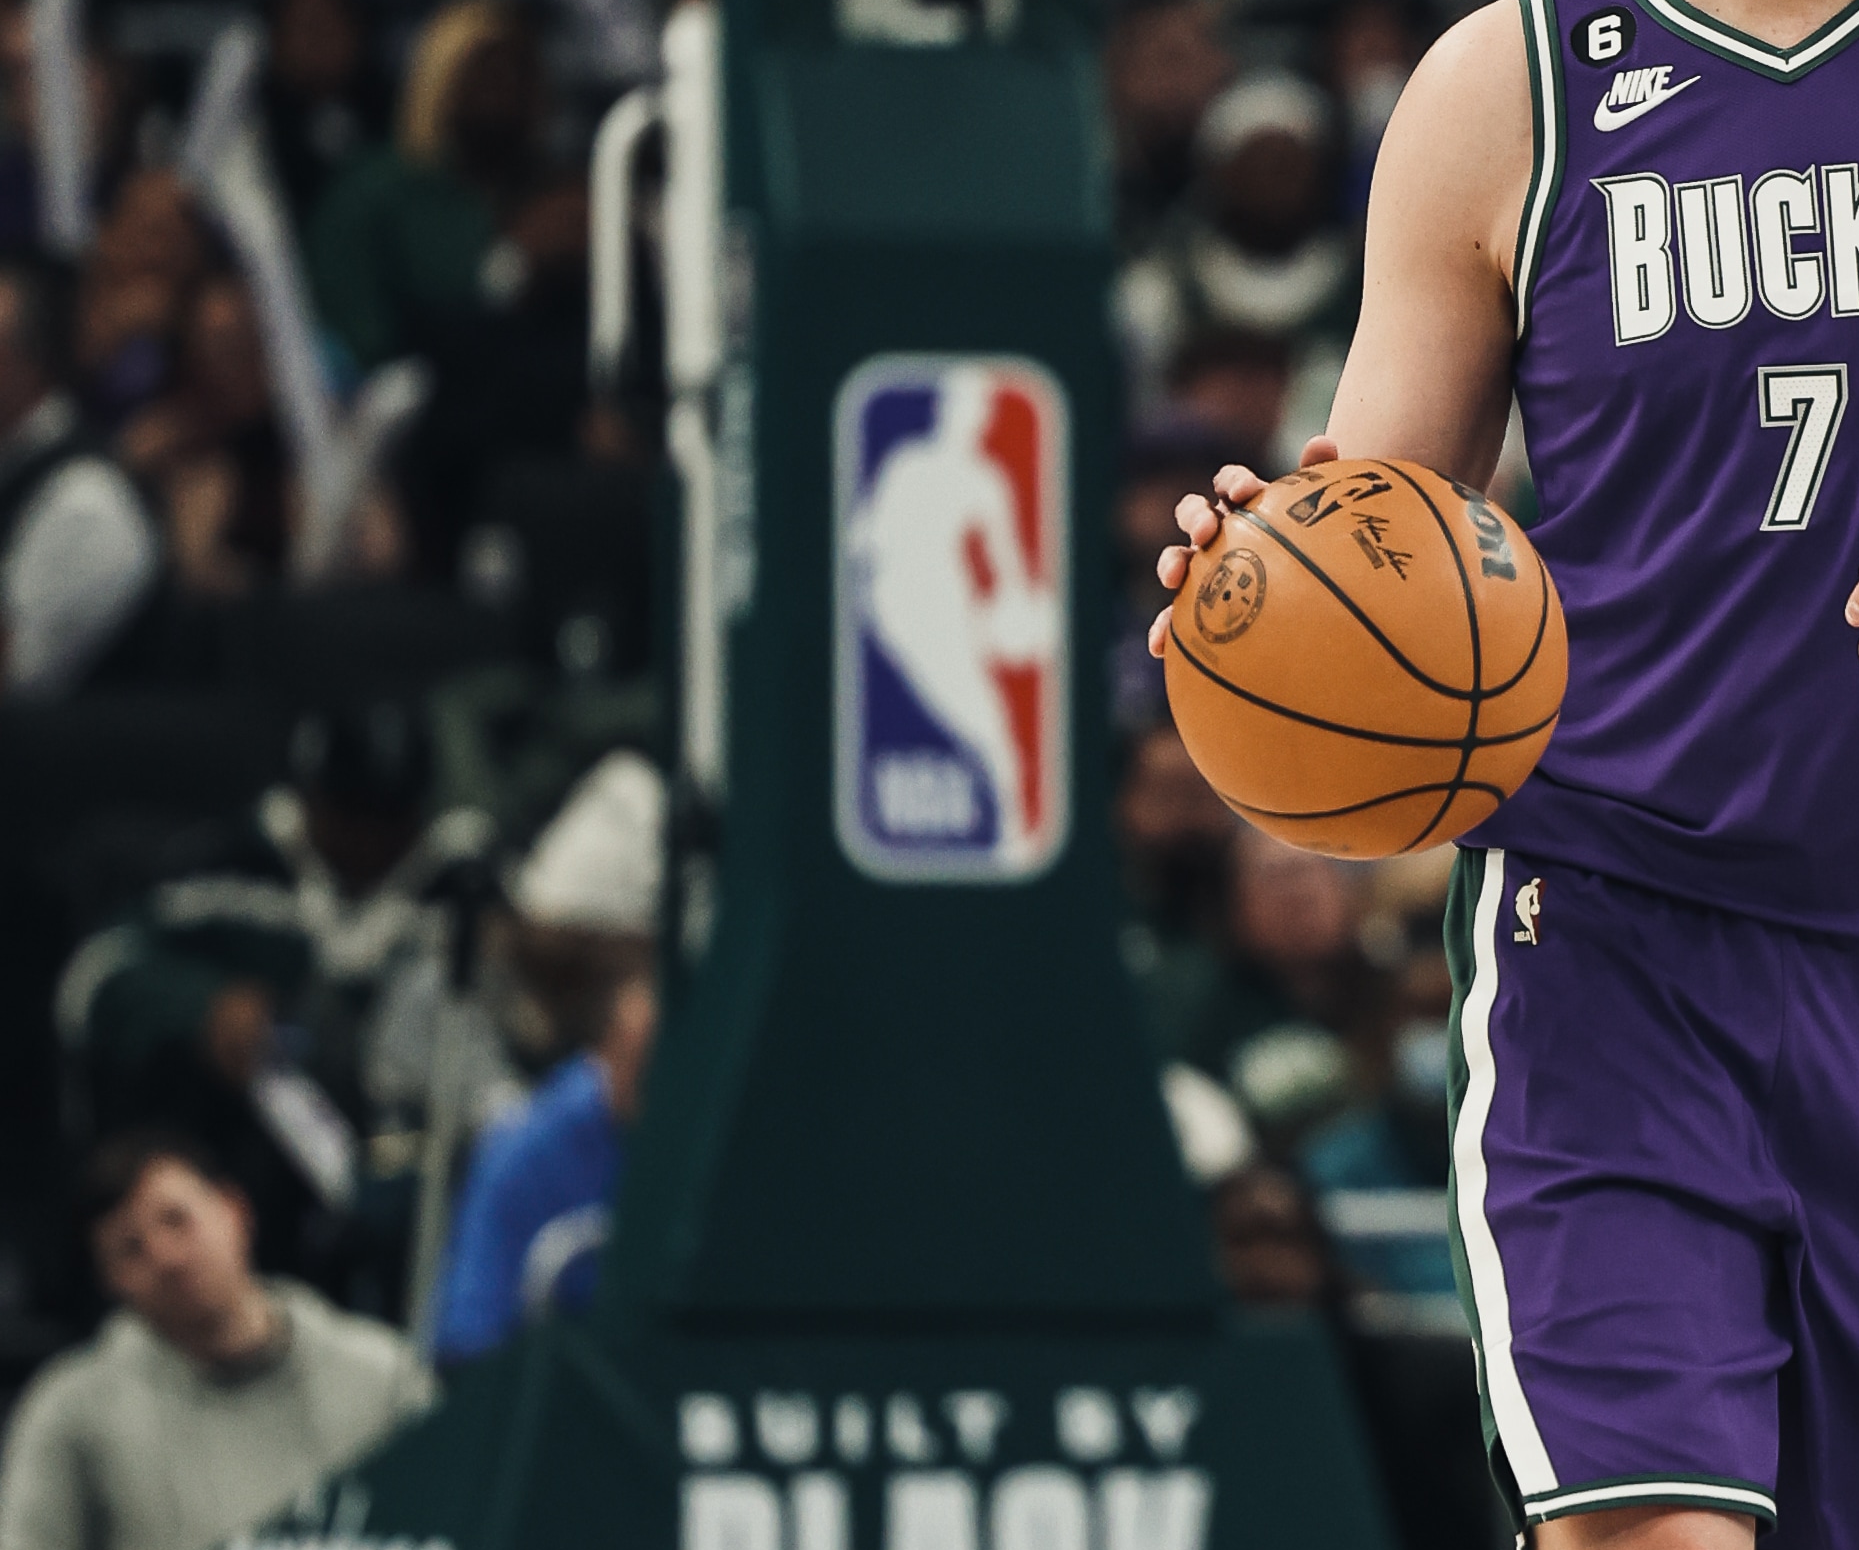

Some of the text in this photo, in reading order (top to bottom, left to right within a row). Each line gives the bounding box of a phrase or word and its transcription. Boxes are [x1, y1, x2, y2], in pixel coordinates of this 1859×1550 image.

[1588, 14, 1622, 61] 6
[1607, 65, 1674, 106] NIKE
[1757, 363, 1848, 531] 7
